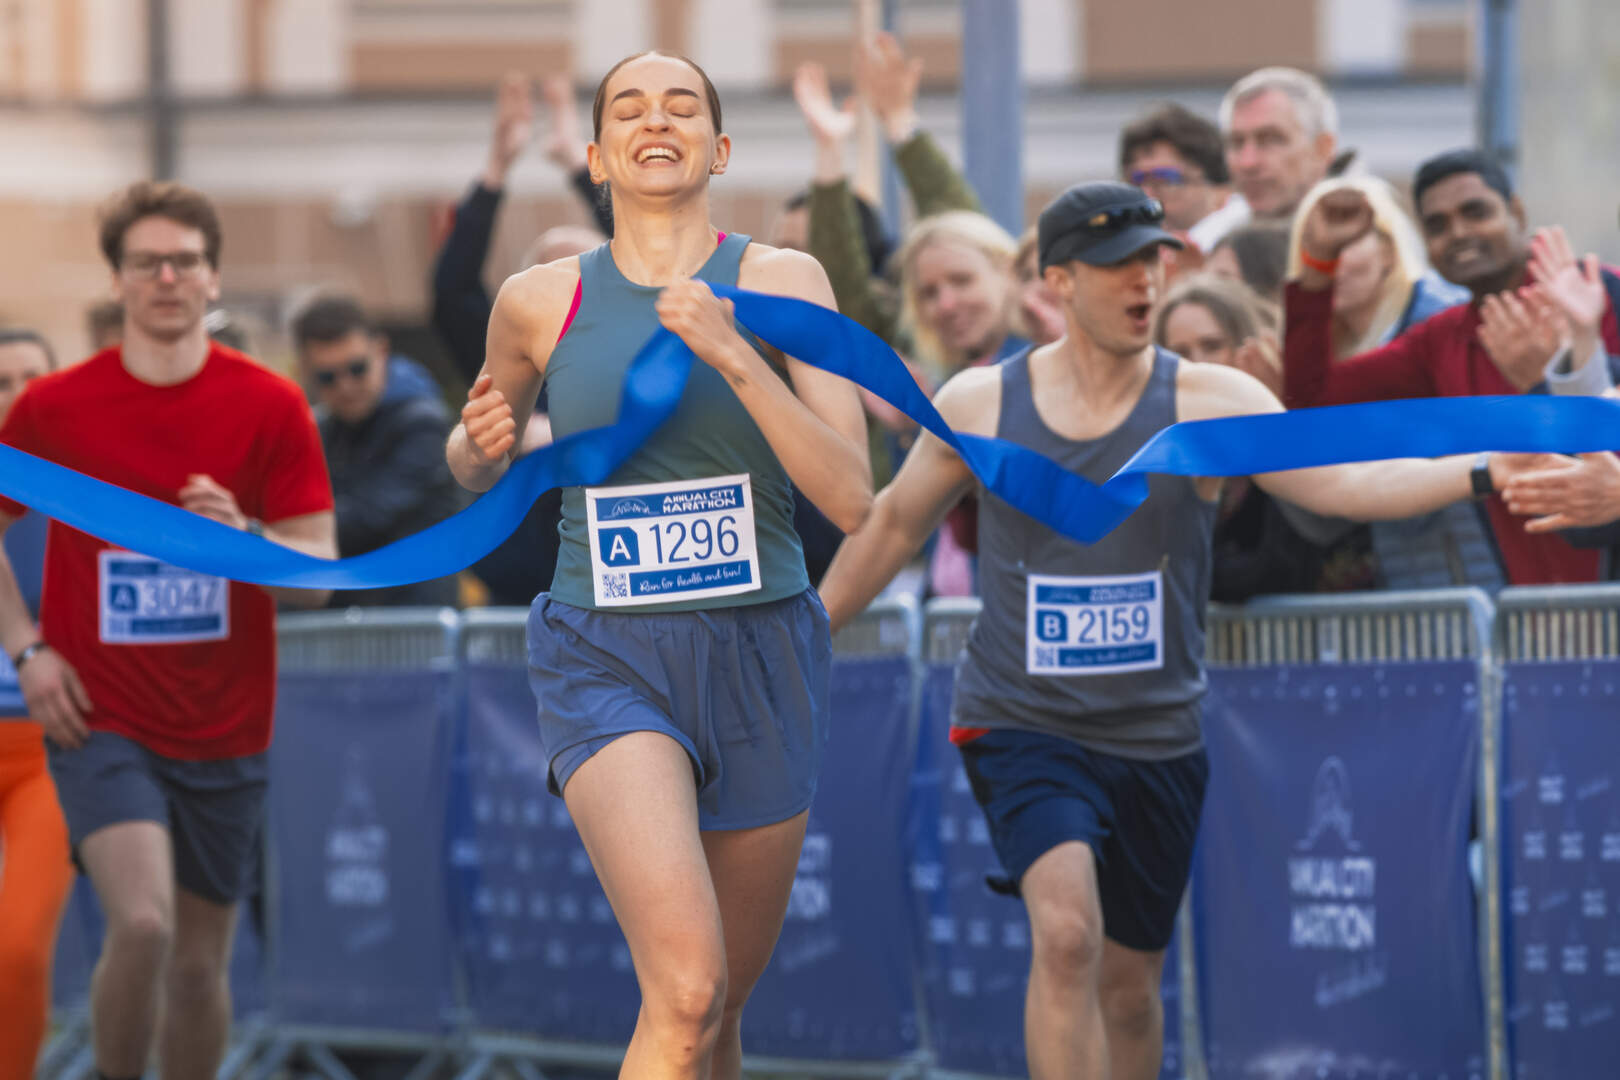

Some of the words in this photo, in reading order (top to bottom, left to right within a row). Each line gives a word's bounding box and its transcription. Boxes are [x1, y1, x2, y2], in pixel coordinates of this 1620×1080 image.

[662, 497, 736, 514] MARATHON
[710, 488, 735, 499] CITY
[609, 534, 632, 561] A
[649, 515, 739, 564] 1296
[114, 586, 135, 609] A
[1044, 614, 1061, 638] B
[1077, 605, 1150, 643] 2159
